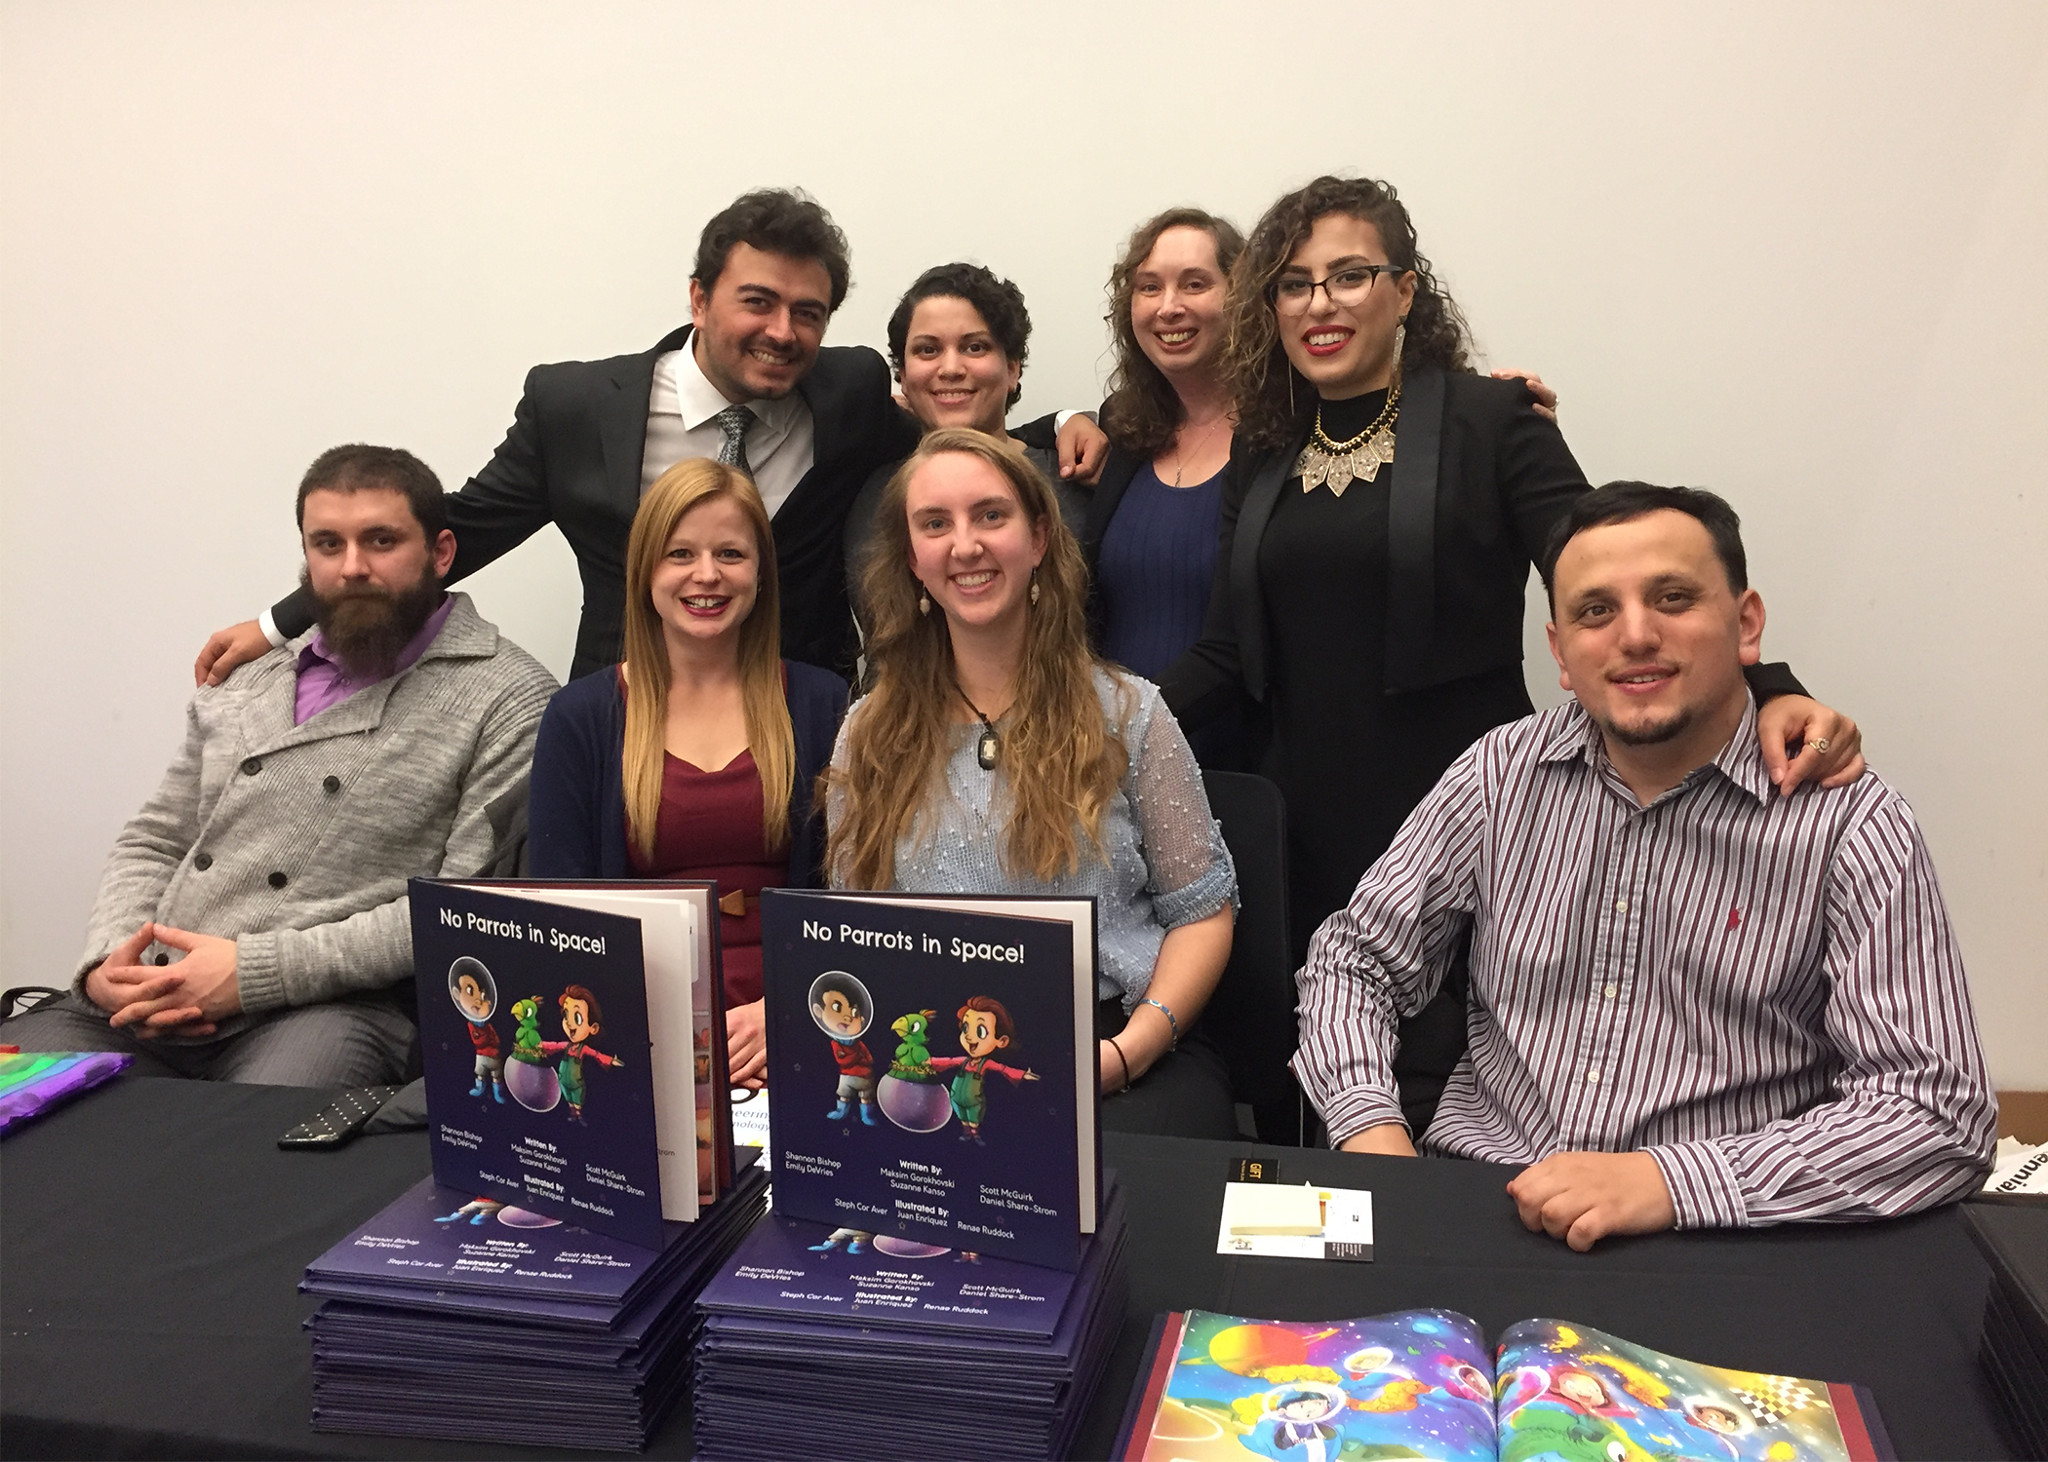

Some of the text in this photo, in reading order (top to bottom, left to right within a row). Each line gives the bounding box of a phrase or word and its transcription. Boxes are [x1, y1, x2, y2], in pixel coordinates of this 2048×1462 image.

[440, 907, 607, 955] No Parrots in Space!
[803, 920, 1025, 963] No Parrots in Space!
[524, 1137, 558, 1154] Written By:
[785, 1151, 842, 1169] Shannon Bishop
[899, 1159, 943, 1176] Written By:
[585, 1163, 626, 1182] Scott McGuirk
[785, 1161, 834, 1177] Emily DeVries
[880, 1167, 955, 1188] Maksim Gorokhovski
[1249, 1163, 1262, 1179] GIFT
[523, 1174, 565, 1194] Illustrated By:
[586, 1173, 645, 1197] Daniel Share-Strom
[890, 1179, 945, 1197] Suzanne Kanso
[526, 1184, 565, 1202] Juan Enriquez
[979, 1184, 1034, 1202] Scott McGuirk
[834, 1198, 888, 1215] Steph Cor Aver
[895, 1199, 950, 1218] Illustrated By:
[979, 1194, 1058, 1217] Daniel Share-Strom
[897, 1209, 948, 1227] Juan Enriquez
[957, 1220, 1015, 1239] Renae Ruddock
[735, 1270, 792, 1281] Emily DeVries
[739, 1265, 805, 1277] Shannon Bishop
[876, 1270, 908, 1279] Written
[849, 1274, 935, 1287] Maksim Gorokhovski
[857, 1281, 894, 1290] Suzanne
[962, 1283, 1022, 1294] Scott McGuirk
[780, 1290, 805, 1299] Steph
[855, 1291, 919, 1303] Illustrated By:
[959, 1289, 1045, 1302] Daniel Share-Strom
[875, 1300, 912, 1309] Enriquez
[924, 1303, 989, 1315] Renae Ruddock
